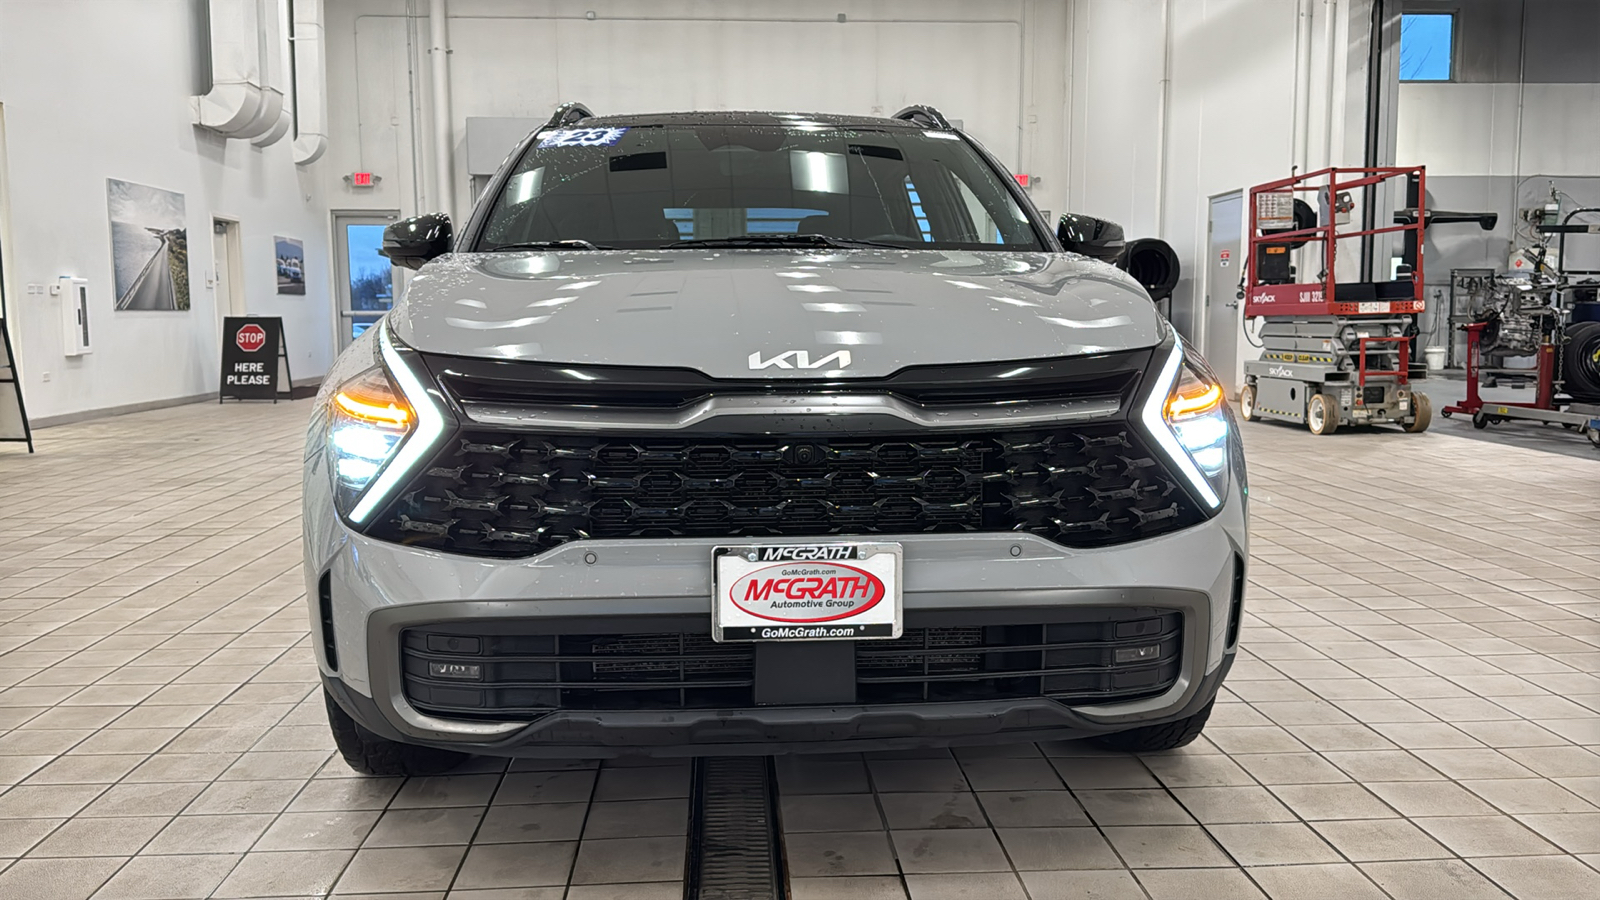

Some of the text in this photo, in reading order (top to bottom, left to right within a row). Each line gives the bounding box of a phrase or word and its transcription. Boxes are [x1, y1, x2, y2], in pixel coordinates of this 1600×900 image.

[564, 131, 608, 142] 23
[238, 333, 264, 343] STOP
[748, 350, 851, 370] KIA
[234, 362, 264, 373] HERE
[1268, 366, 1293, 377] SKYJACK
[227, 375, 270, 385] PLEASE
[781, 568, 837, 577] GoMcGrath.com
[770, 600, 855, 609] Automotive Group
[761, 626, 854, 639] GoMcGrath.com
